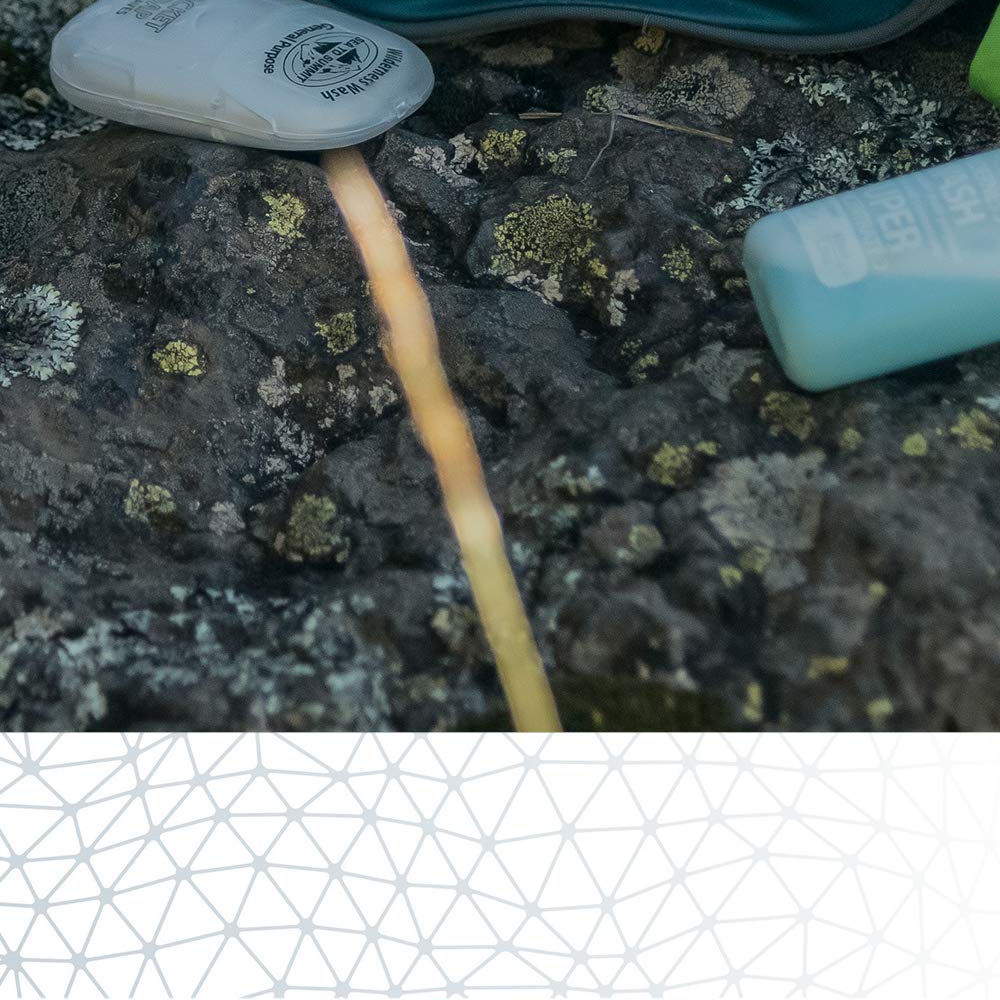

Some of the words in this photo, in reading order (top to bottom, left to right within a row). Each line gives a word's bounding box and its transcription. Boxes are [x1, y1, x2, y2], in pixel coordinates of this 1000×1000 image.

[283, 22, 335, 44] General
[342, 36, 366, 49] SEA
[263, 40, 292, 74] Purpose
[332, 46, 348, 56] TO
[296, 54, 334, 83] SUMMIT
[358, 47, 404, 86] Wilderness
[320, 82, 366, 101] Wash
